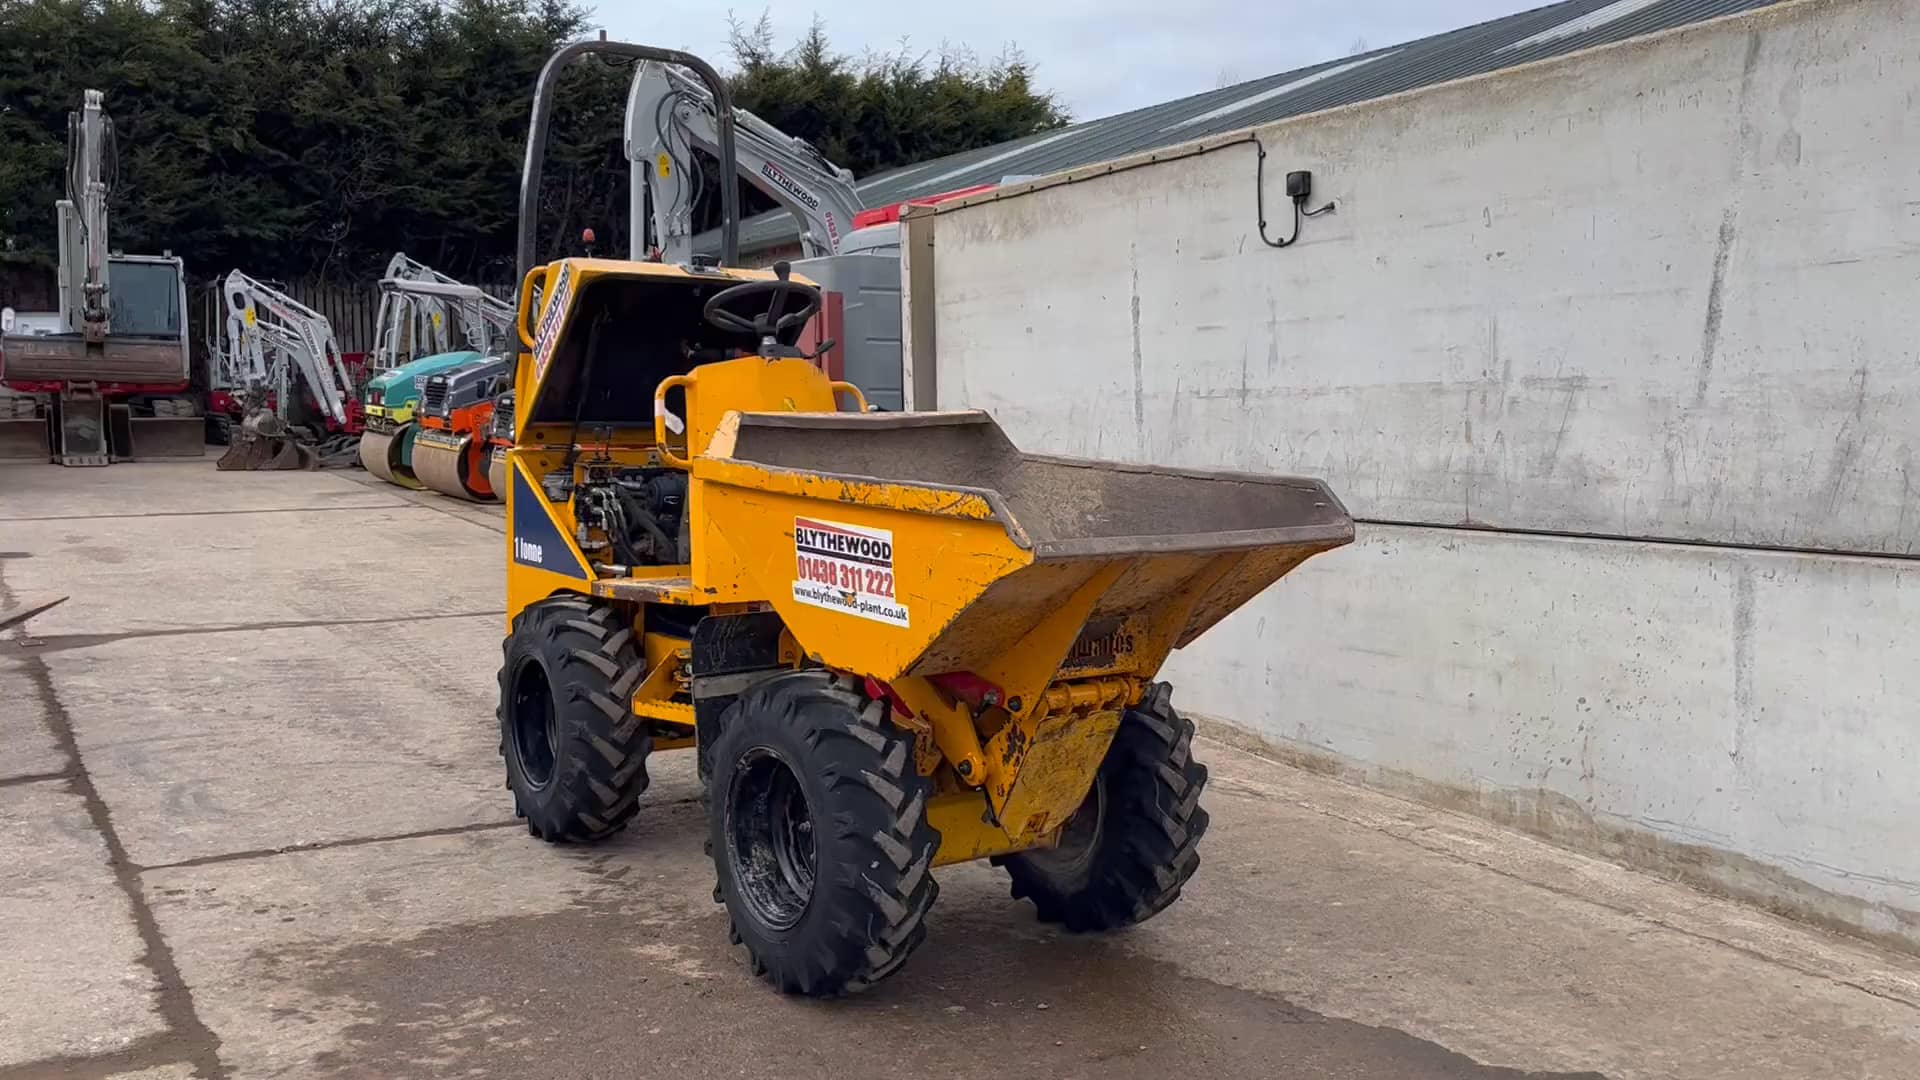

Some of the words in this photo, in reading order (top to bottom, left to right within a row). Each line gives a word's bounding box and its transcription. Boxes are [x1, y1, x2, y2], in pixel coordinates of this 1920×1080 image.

[762, 164, 819, 208] BLYTHEWOOD
[514, 536, 519, 559] 1
[520, 537, 542, 563] tonne
[796, 527, 892, 560] BLYTHEWOOD
[798, 555, 838, 587] 01438
[840, 563, 863, 593] 311
[866, 569, 894, 598] 222
